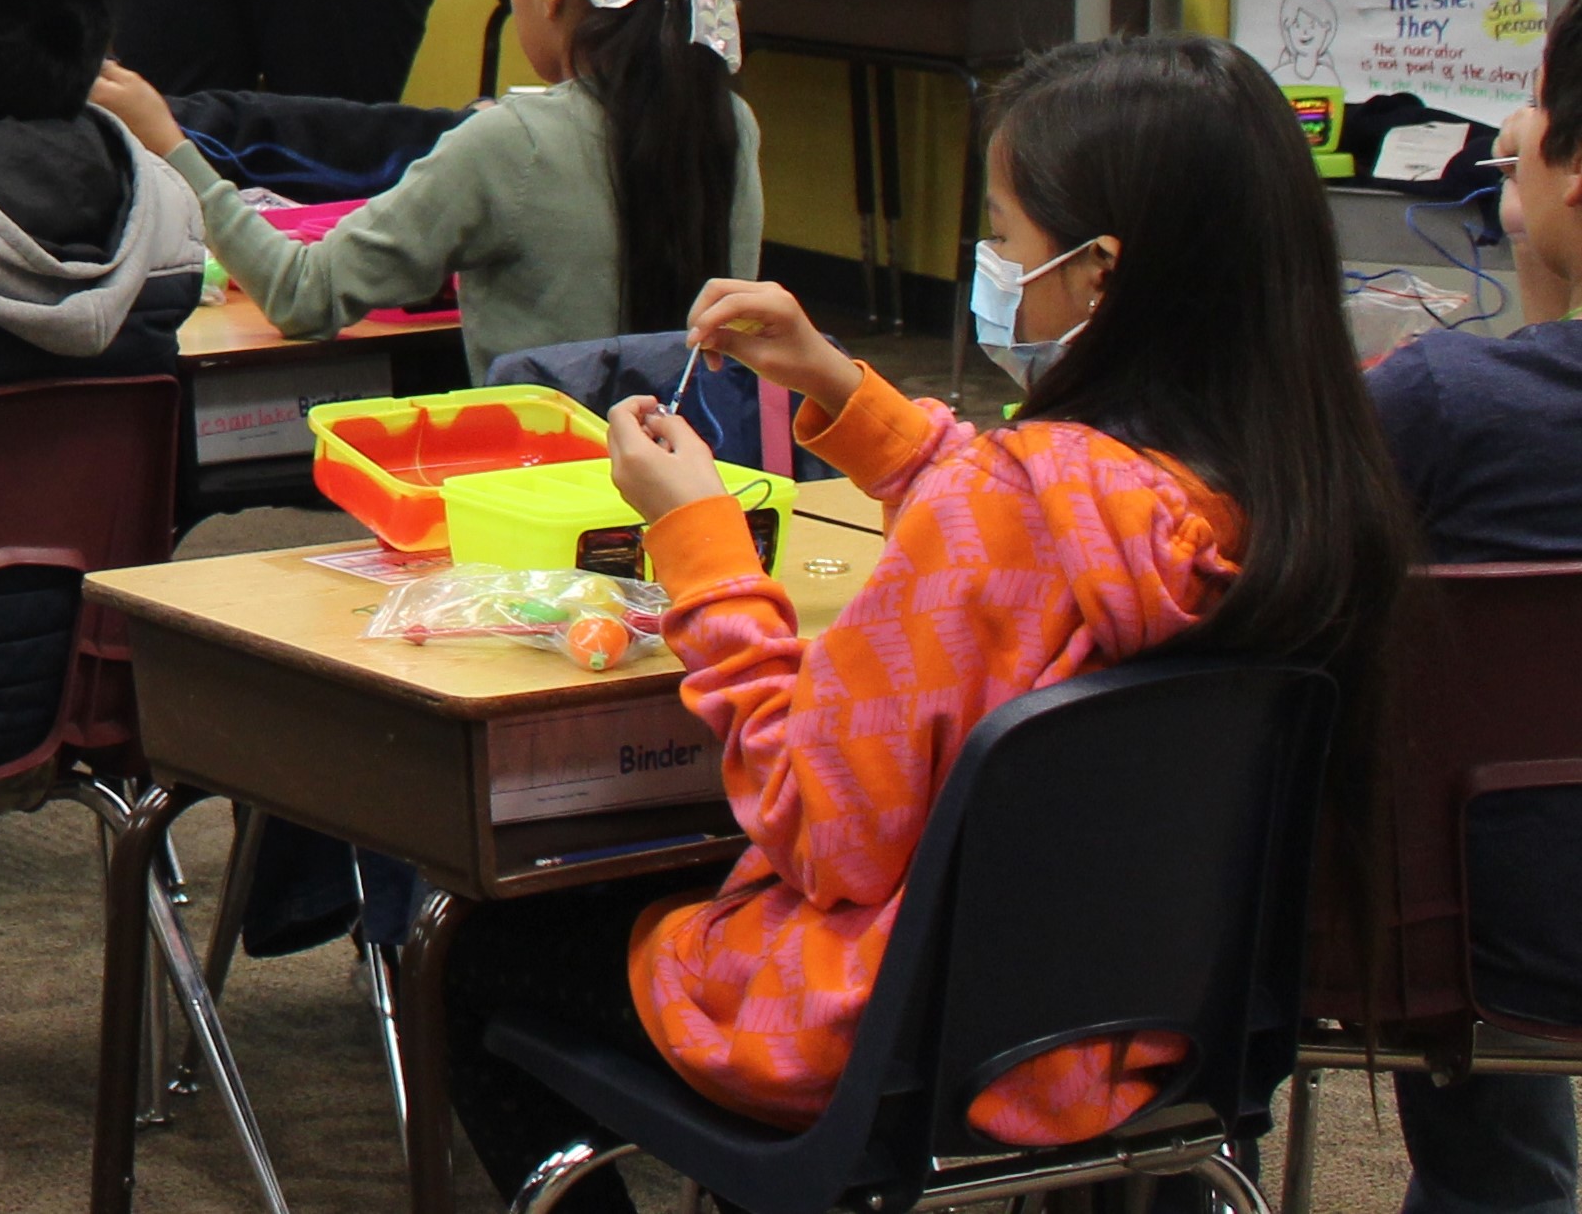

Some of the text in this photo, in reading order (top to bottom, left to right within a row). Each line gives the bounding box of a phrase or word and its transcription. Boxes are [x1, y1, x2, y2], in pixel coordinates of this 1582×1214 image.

[1396, 15, 1450, 43] they
[1494, 18, 1548, 41] person
[1373, 43, 1466, 59] the narrator
[1361, 59, 1372, 72] is
[1377, 60, 1398, 70] not
[1406, 60, 1435, 77] part
[1462, 64, 1485, 80] the
[1488, 66, 1529, 89] story
[620, 739, 703, 775] Binder
